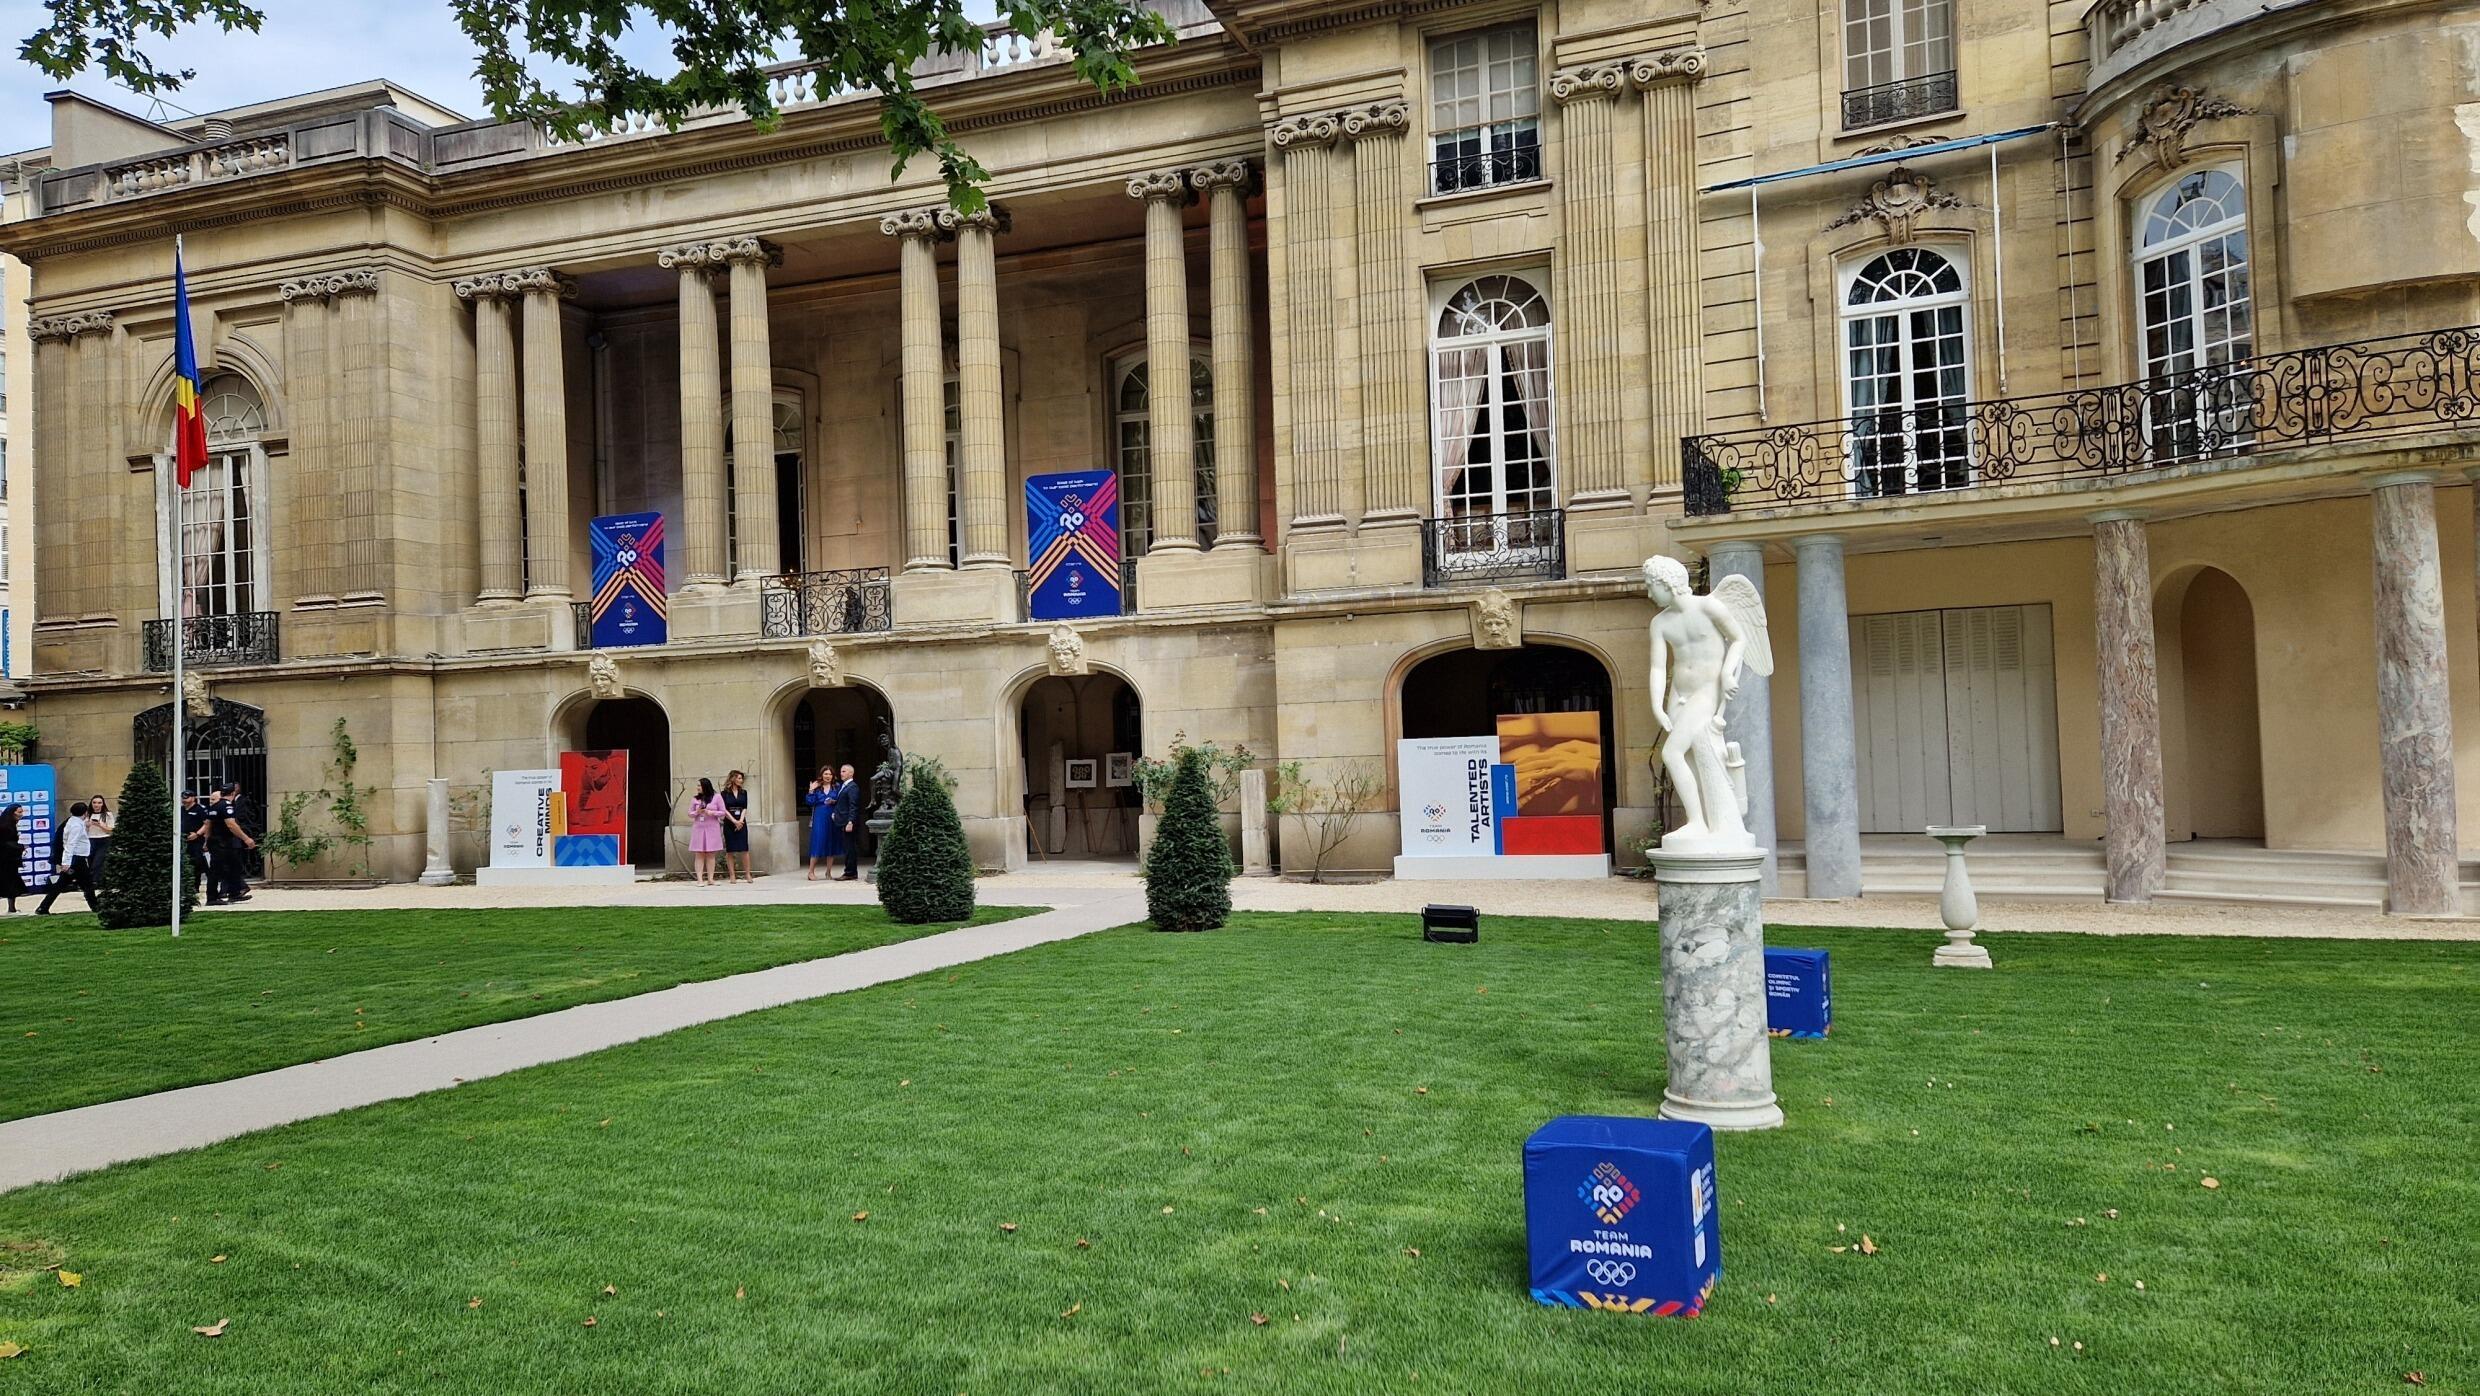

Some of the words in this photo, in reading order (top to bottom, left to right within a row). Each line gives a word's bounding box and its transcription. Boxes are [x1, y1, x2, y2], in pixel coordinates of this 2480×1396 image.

[1059, 512, 1084, 531] RO
[616, 550, 637, 567] RO
[1468, 759, 1480, 843] TALENTED
[1479, 758, 1490, 827] ARTISTS
[536, 788, 544, 857] CREATIVE
[1593, 1185, 1624, 1208] RO
[1593, 1229, 1629, 1242] TEAM
[1570, 1239, 1653, 1259] ROMANIA
